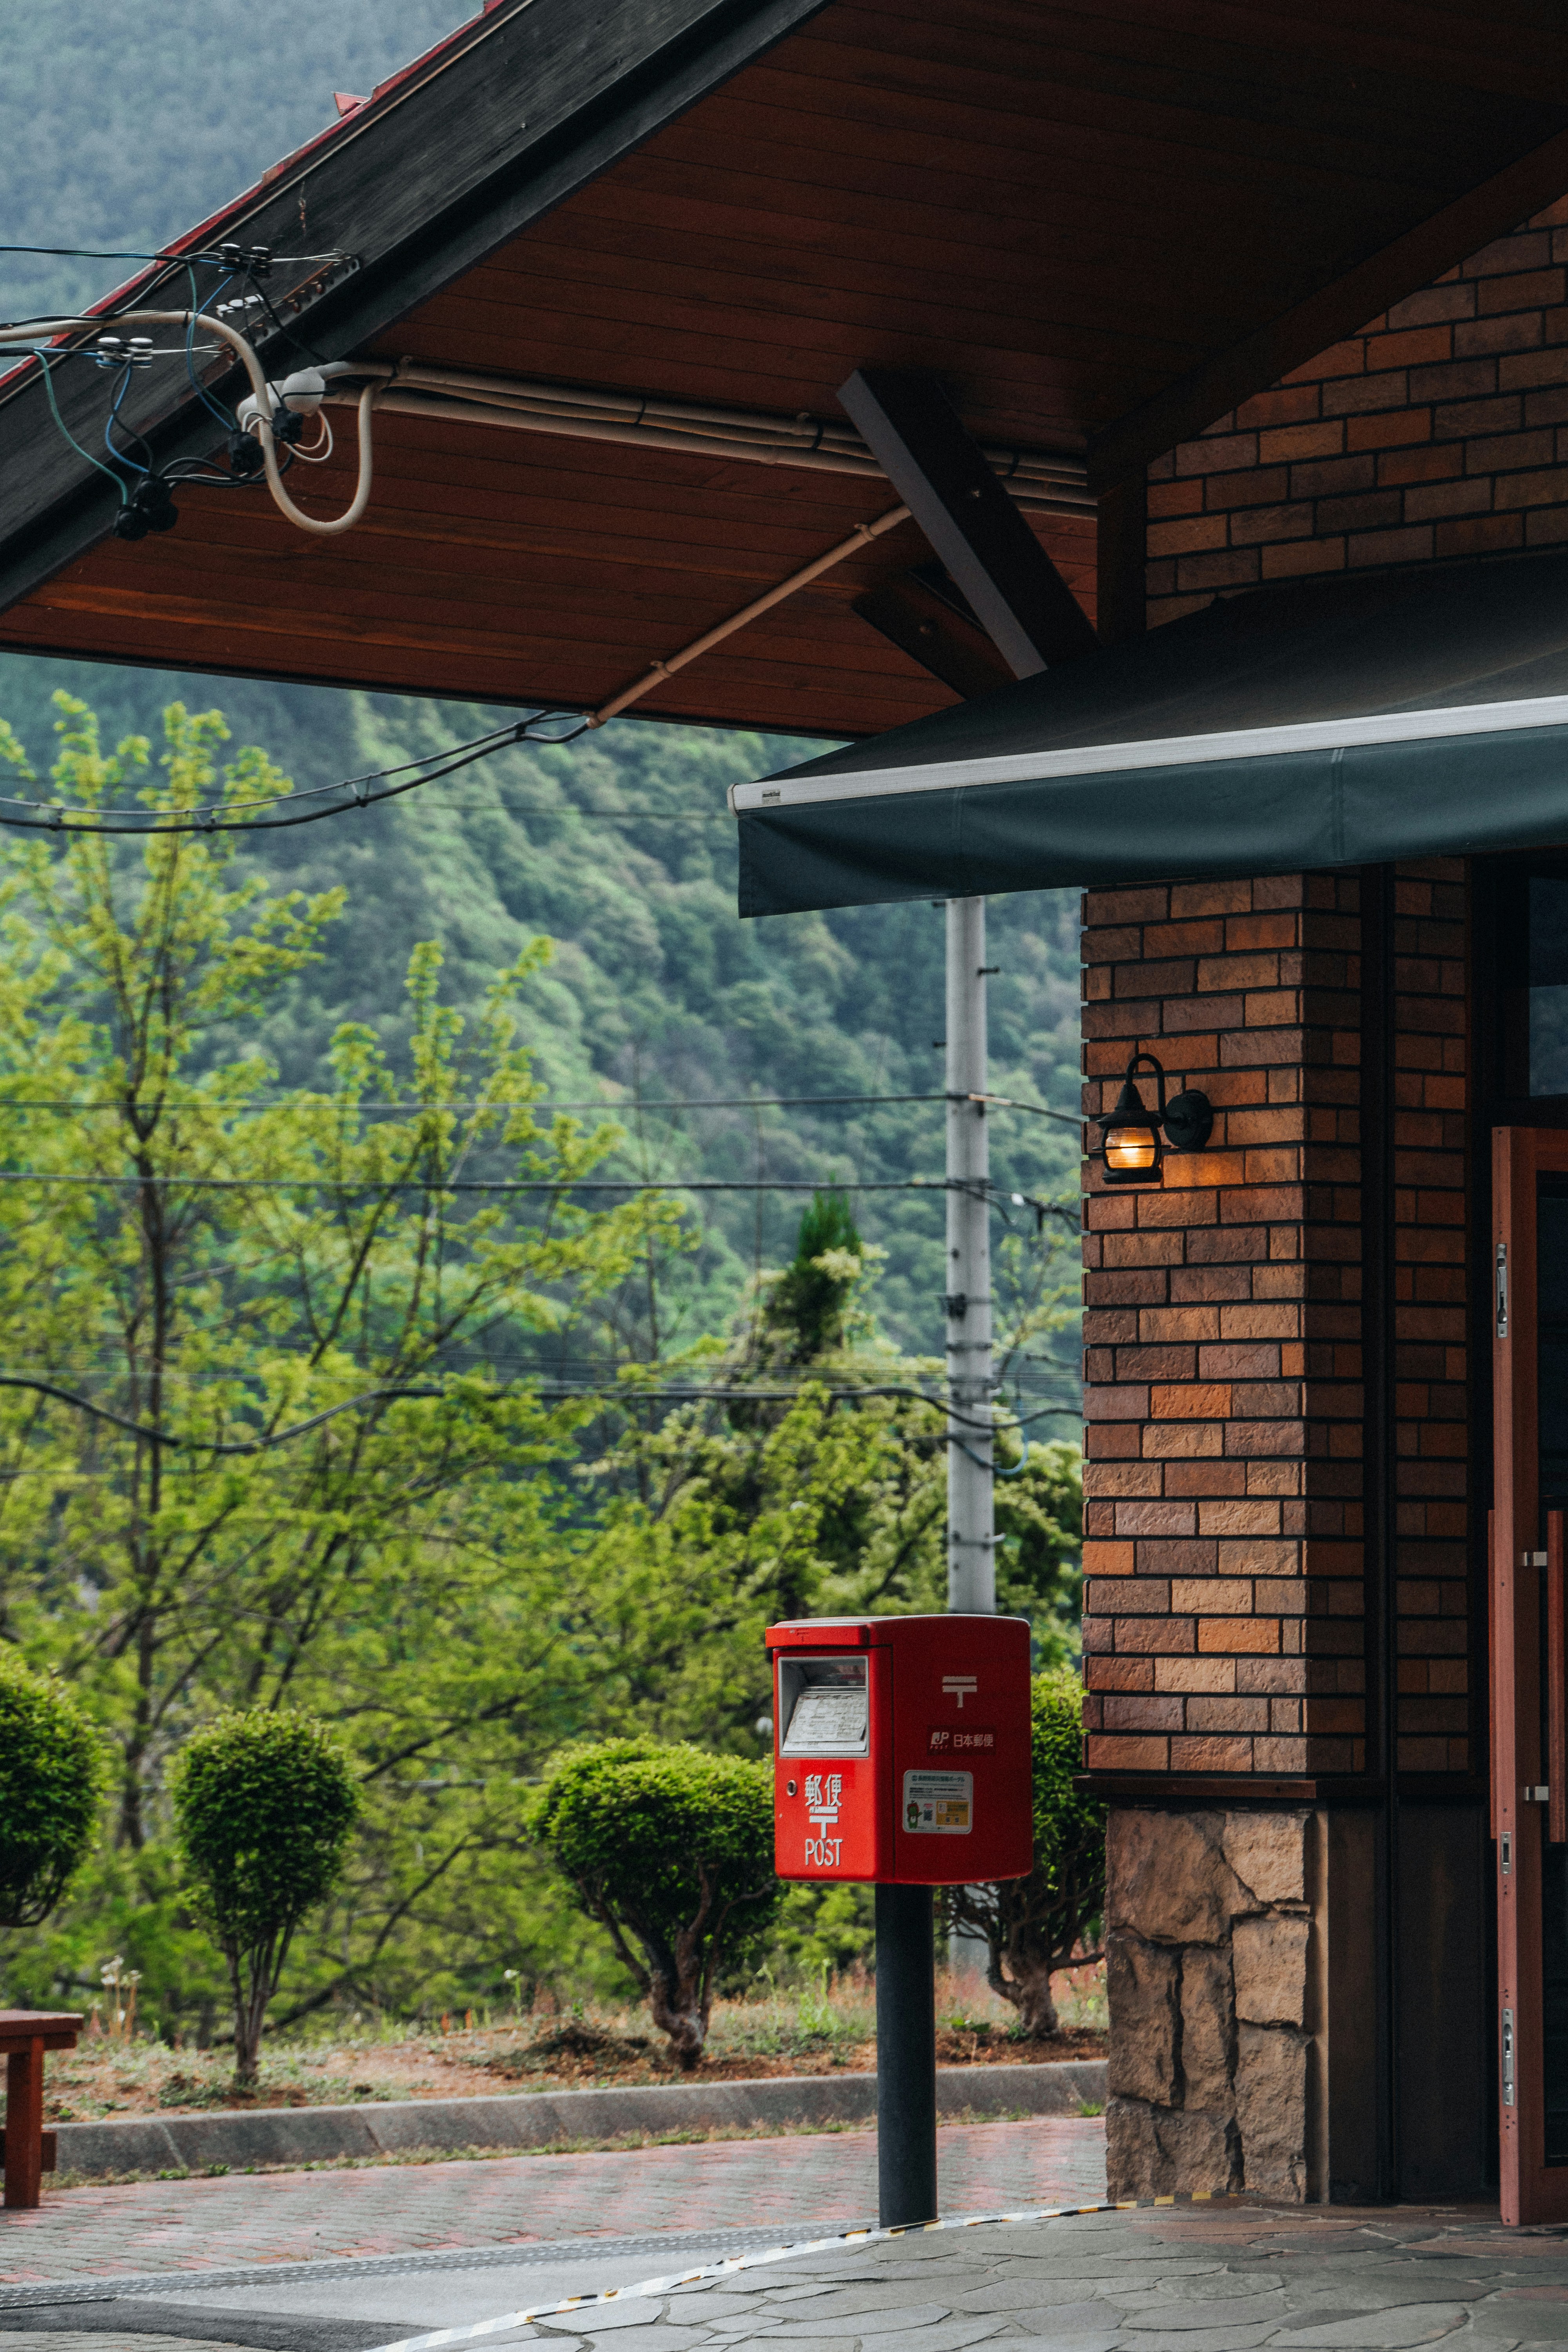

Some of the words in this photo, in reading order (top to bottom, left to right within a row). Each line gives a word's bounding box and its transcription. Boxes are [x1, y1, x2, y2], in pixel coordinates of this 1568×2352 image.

[954, 1734, 993, 1747] 日本郵便
[805, 1774, 842, 1806] 郵便
[805, 1838, 843, 1866] POST
